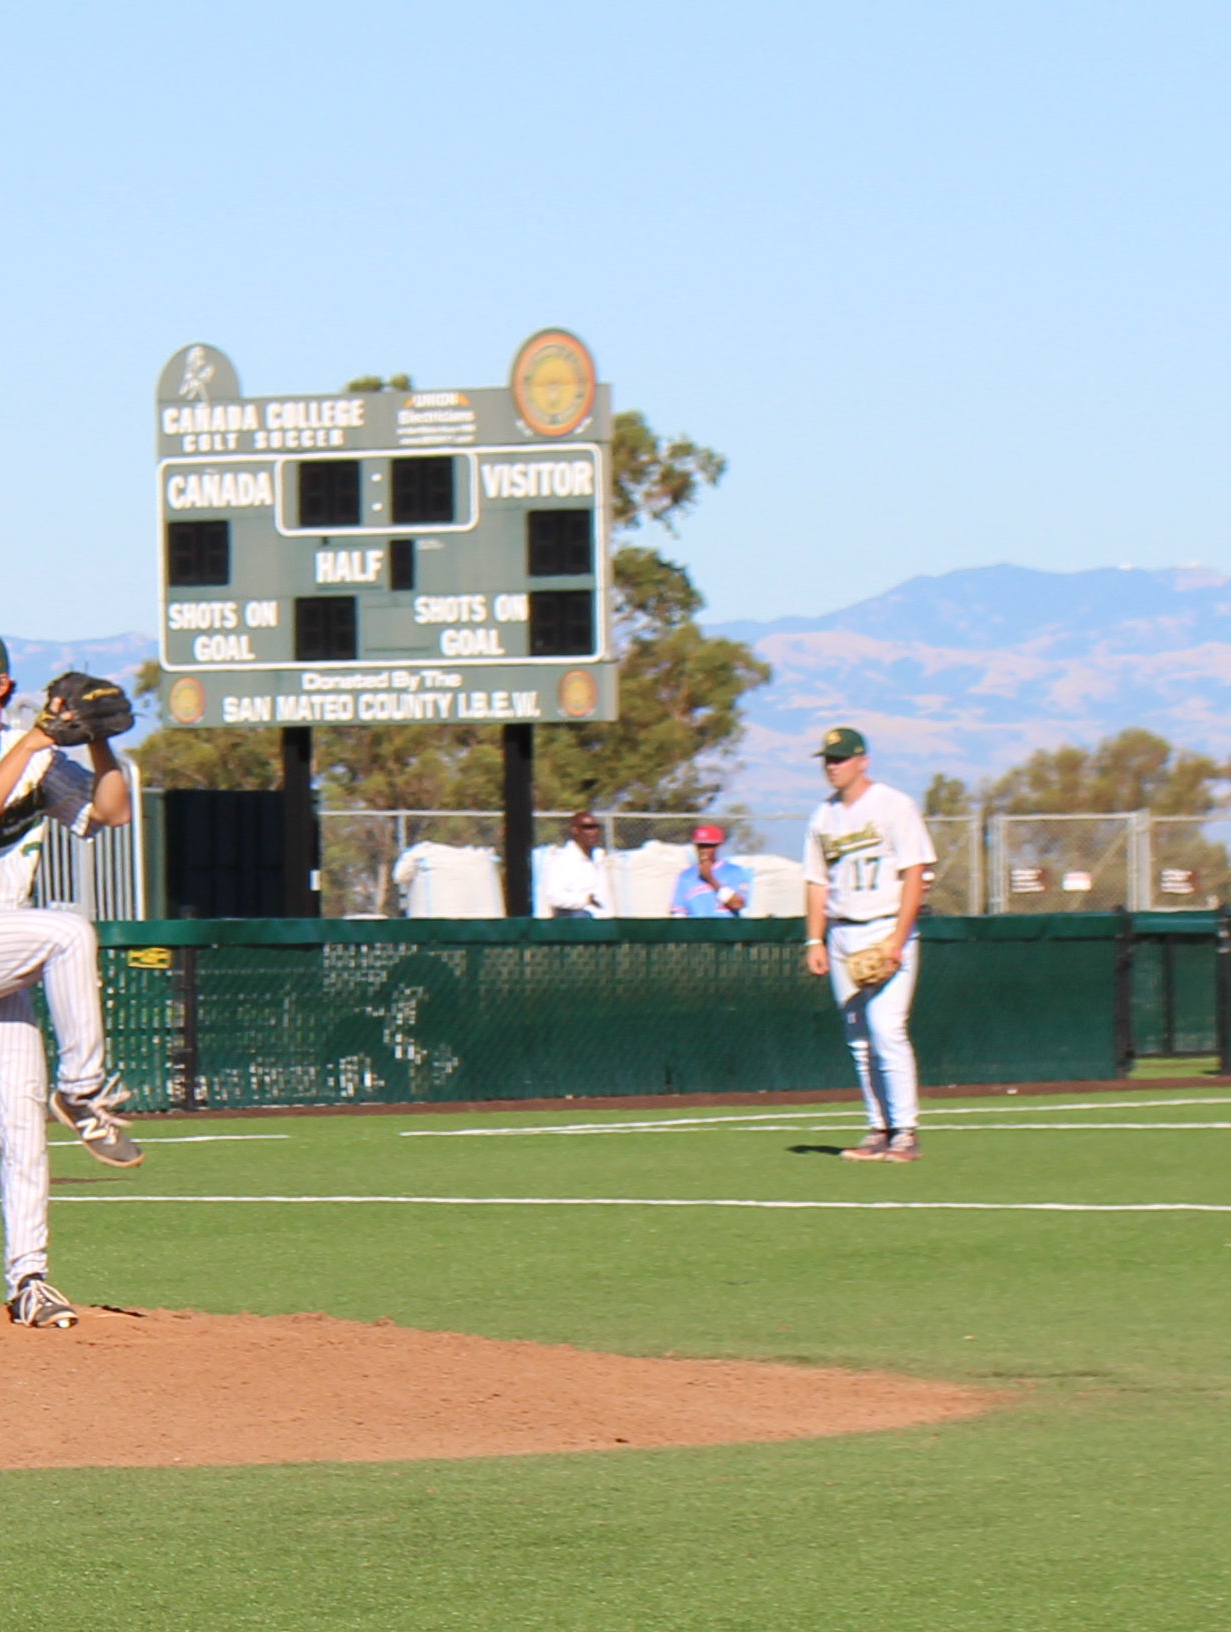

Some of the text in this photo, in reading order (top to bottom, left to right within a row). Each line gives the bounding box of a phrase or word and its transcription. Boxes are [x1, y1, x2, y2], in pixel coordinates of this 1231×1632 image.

[162, 399, 365, 434] CAÑADA COLLEGE
[182, 428, 345, 453] COLT SOCCER
[168, 468, 273, 509] CAÑADA
[481, 461, 594, 498] VISITOR
[315, 550, 384, 583] HALF
[169, 601, 279, 630] SHOTS ON
[414, 593, 529, 623] SHOTS ON
[194, 634, 256, 661] GOAL
[440, 629, 505, 656] GOAL
[301, 670, 463, 692] Donated By The
[223, 696, 272, 723] SAN
[276, 694, 355, 721] MATEO
[358, 691, 454, 721] COUNTY
[852, 857, 882, 890] 17
